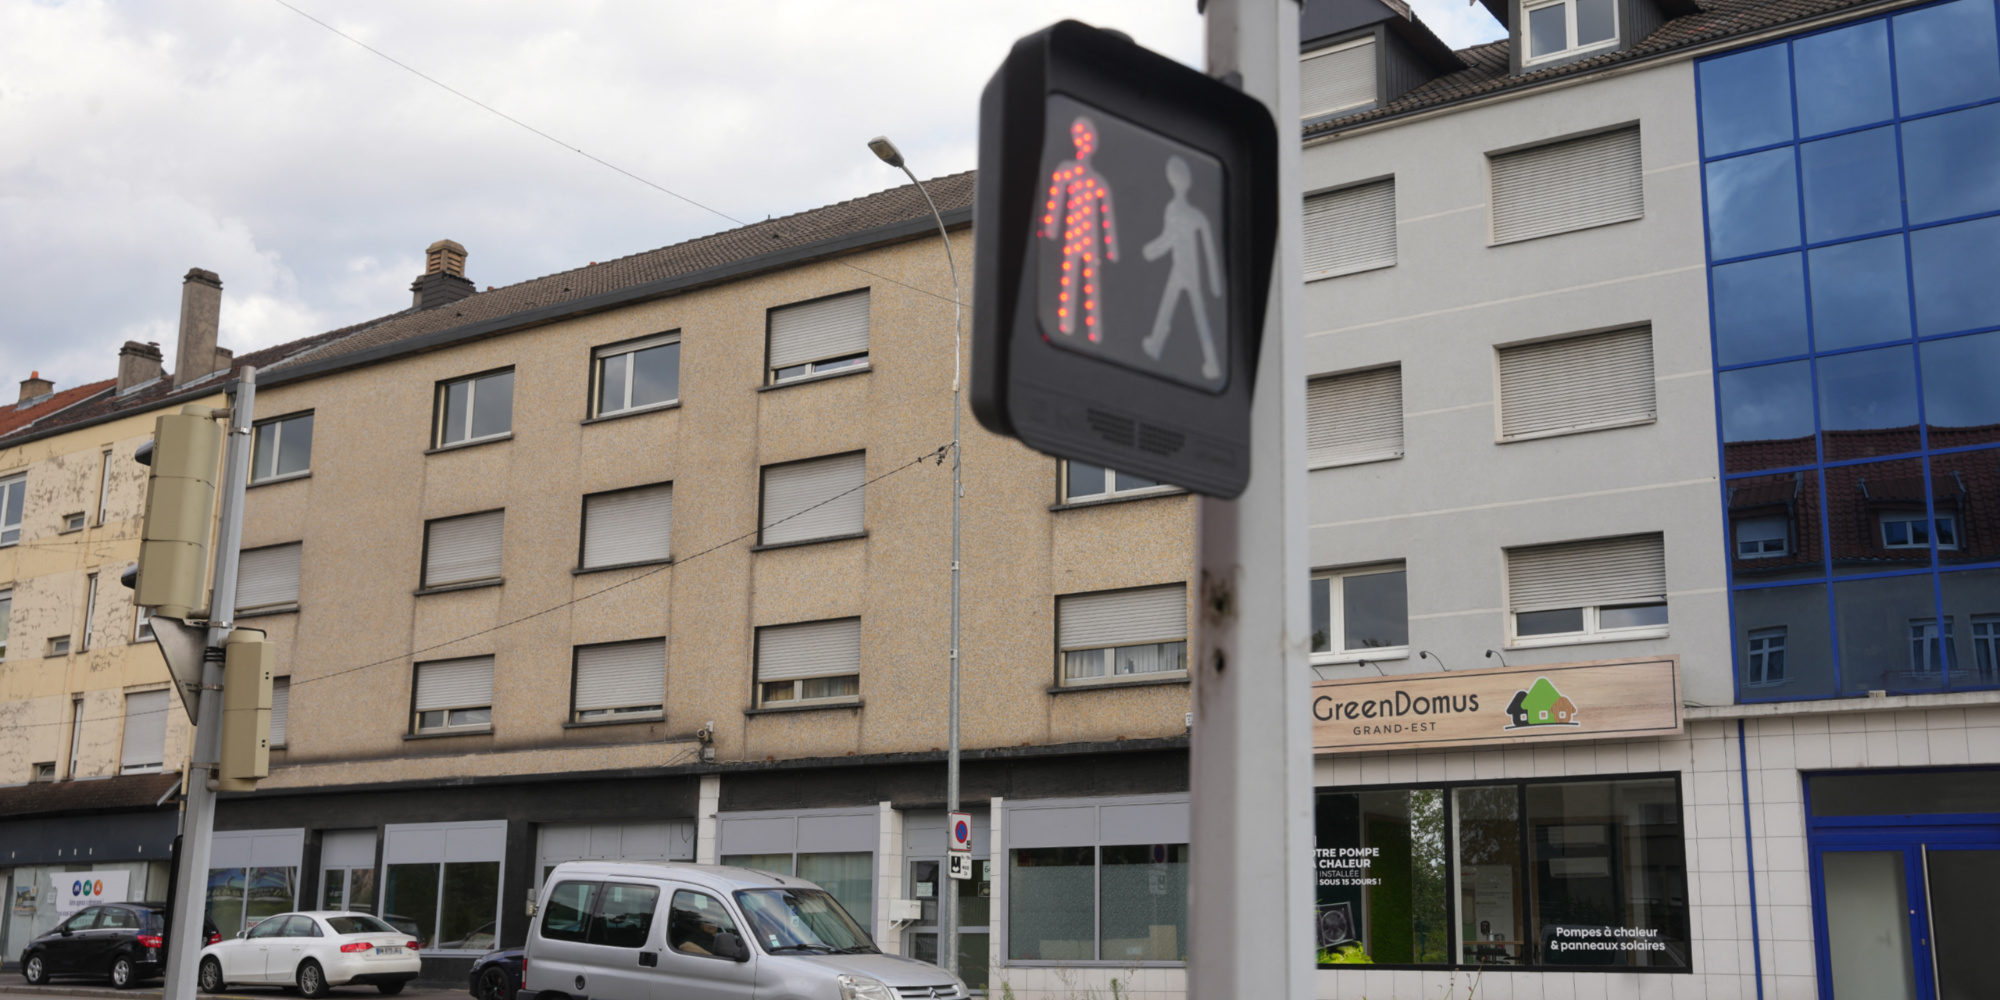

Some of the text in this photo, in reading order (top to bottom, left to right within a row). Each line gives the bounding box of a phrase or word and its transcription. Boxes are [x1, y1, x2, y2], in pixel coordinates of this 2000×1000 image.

[1312, 690, 1480, 721] GreenDomus
[1353, 721, 1437, 736] GRAND-EST
[1312, 847, 1380, 858] OTRE POMPE
[1319, 858, 1371, 868] CHALEUR
[1319, 869, 1359, 877] INSTALLÉE
[1351, 878, 1377, 886] JOURS
[1556, 925, 1658, 939] Pompes à chaleur
[1550, 939, 1666, 952] & panneaux solaires
